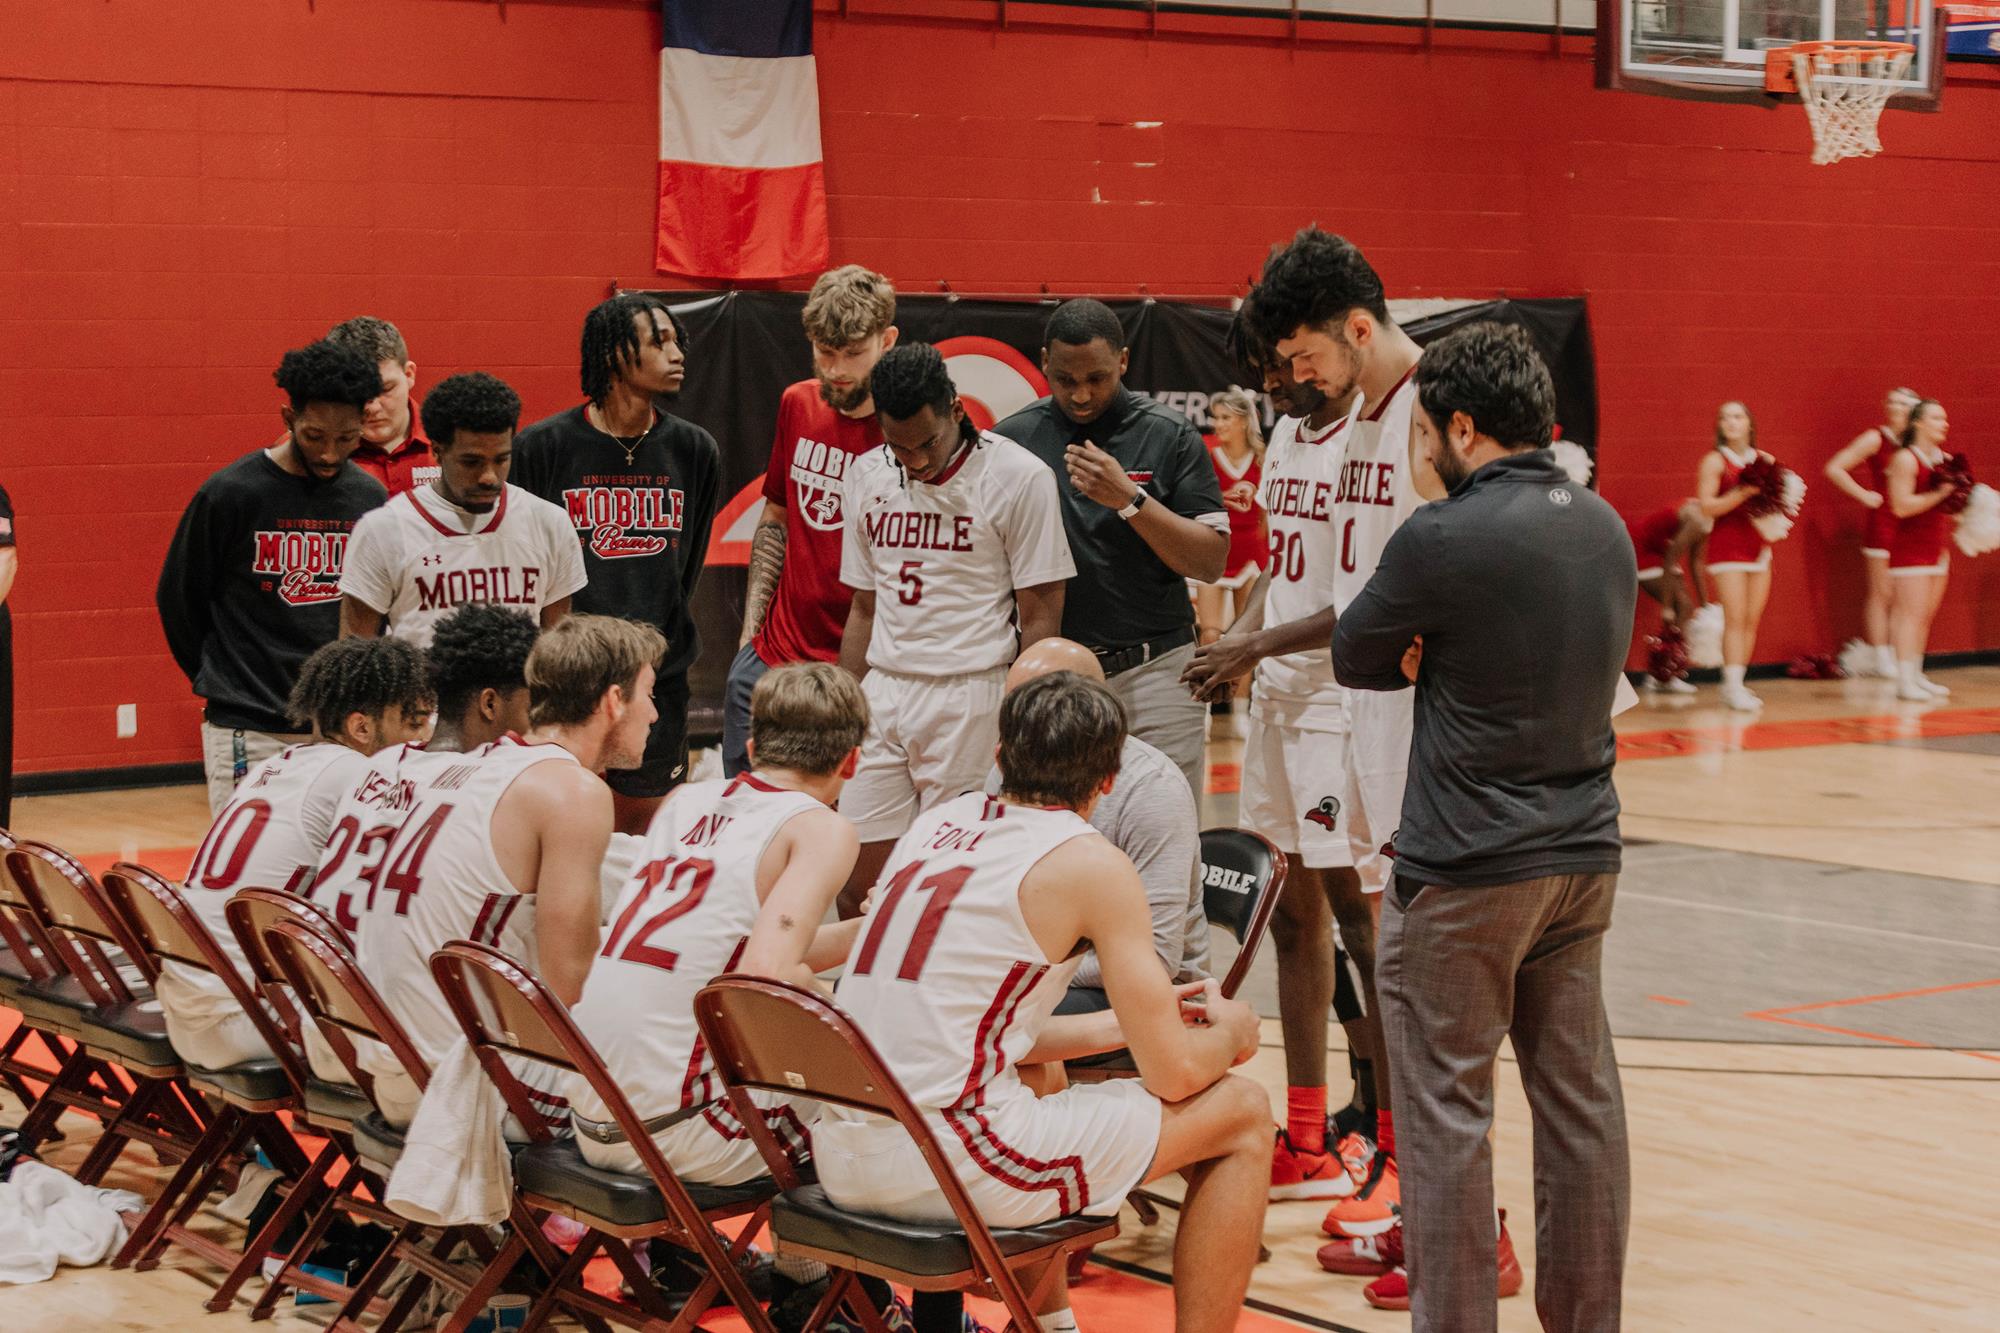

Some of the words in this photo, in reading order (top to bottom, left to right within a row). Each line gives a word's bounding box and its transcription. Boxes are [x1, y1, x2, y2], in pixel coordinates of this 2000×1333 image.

[583, 474, 651, 486] UNIVERSITY
[656, 475, 670, 487] OF
[276, 518, 341, 530] UNIVERSITY
[562, 487, 684, 532] MOBILE
[865, 511, 974, 552] MOBILE
[590, 522, 667, 559] Rams
[414, 566, 540, 611] MOBILE
[898, 560, 924, 606] 5
[600, 855, 716, 972] 12
[853, 860, 975, 983] 11
